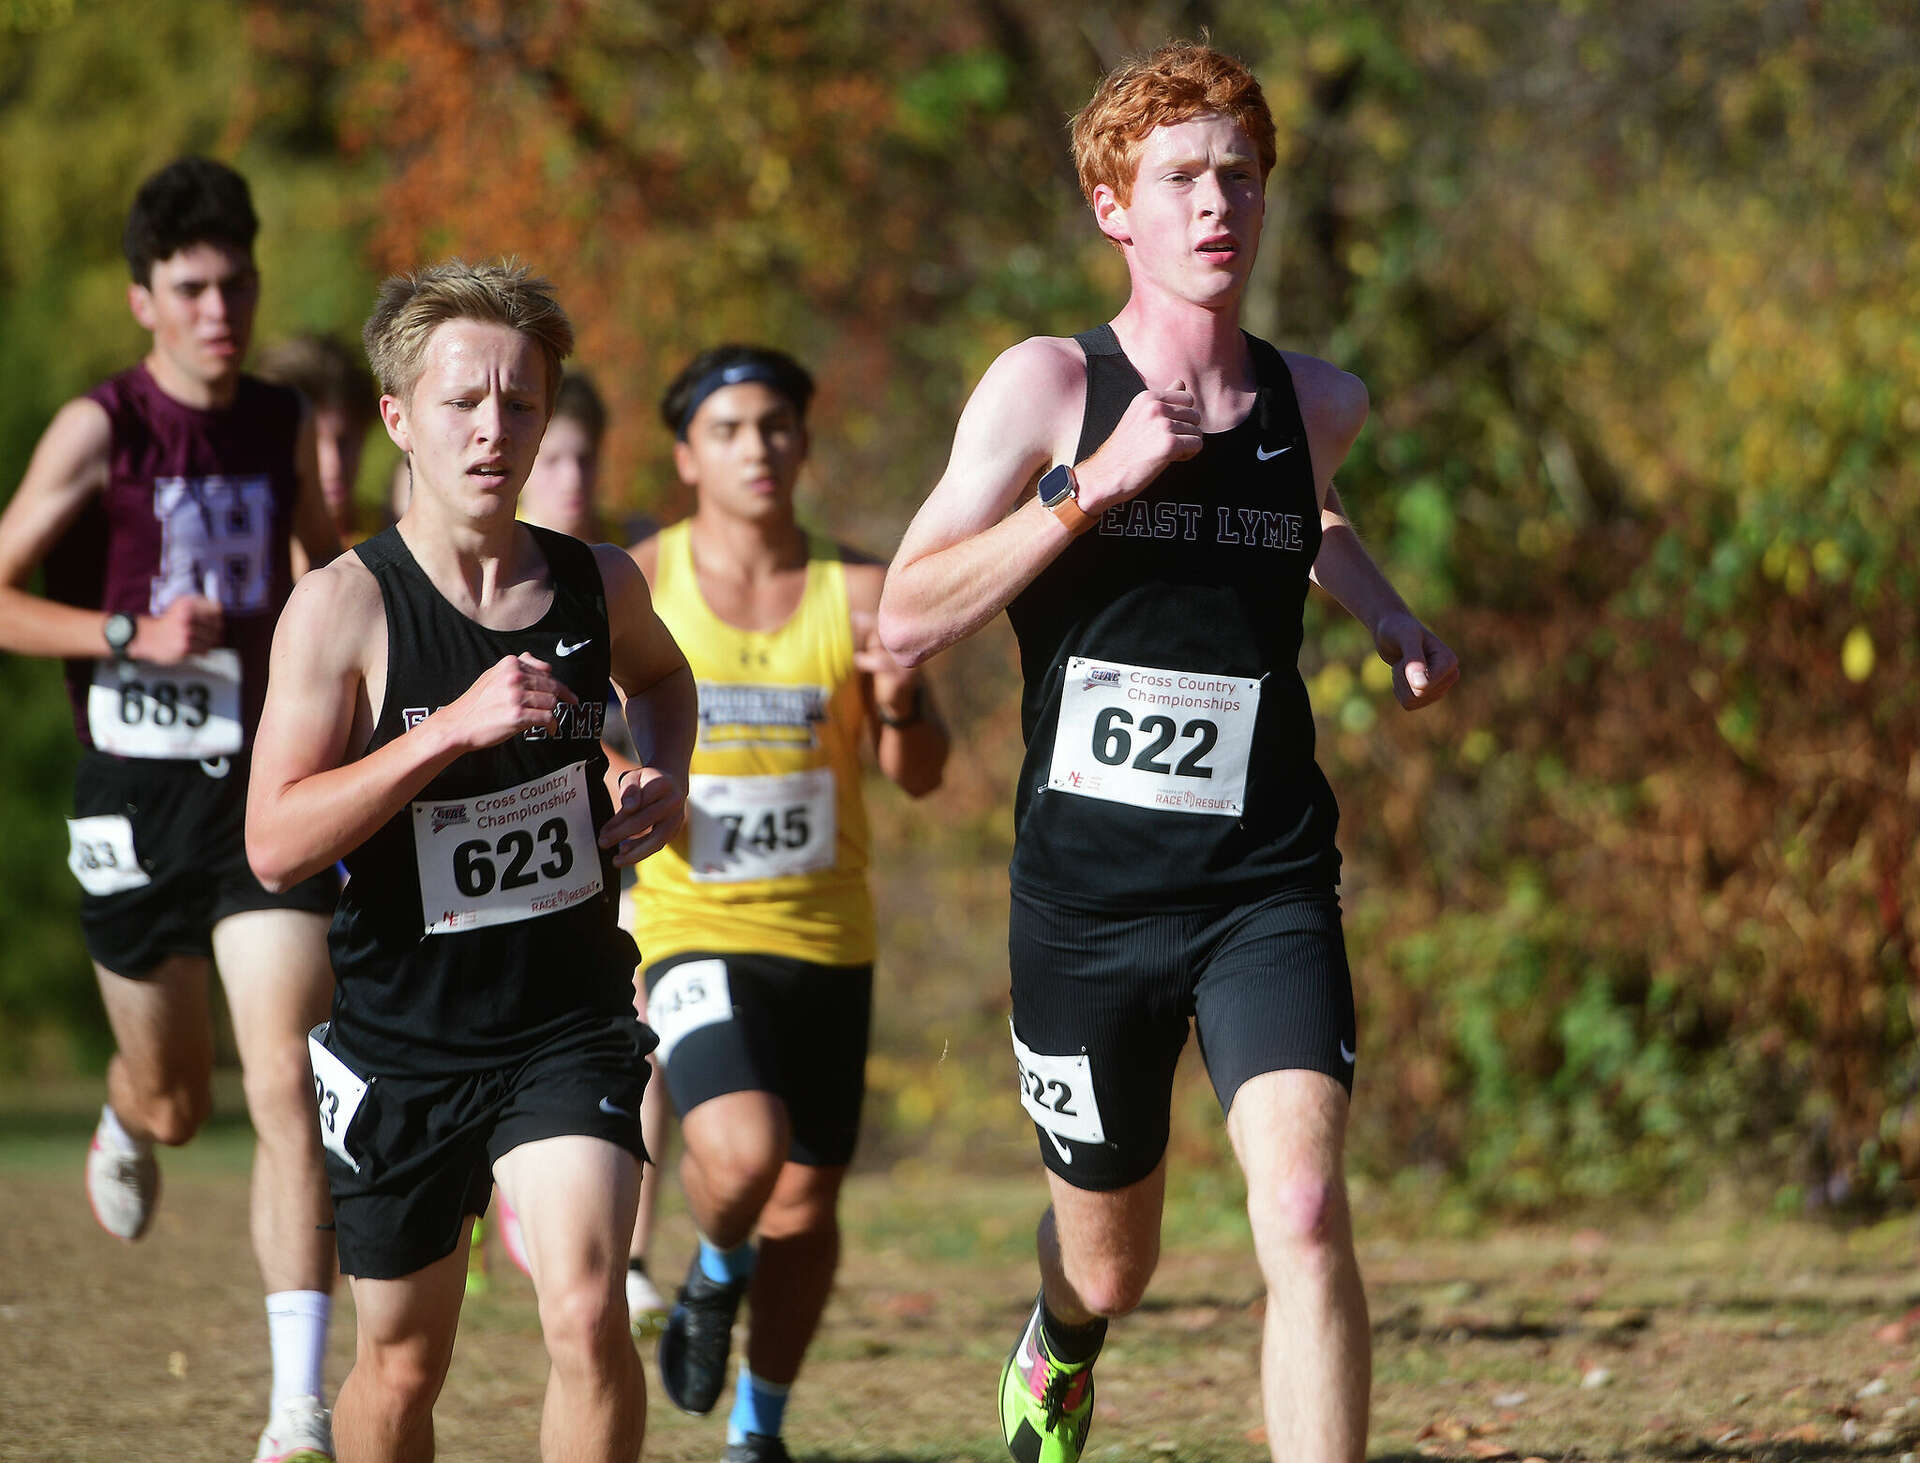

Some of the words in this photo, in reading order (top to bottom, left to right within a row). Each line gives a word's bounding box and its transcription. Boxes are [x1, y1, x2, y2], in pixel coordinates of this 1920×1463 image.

[1100, 500, 1202, 540] EAST
[1216, 507, 1303, 551] LYME
[120, 681, 210, 727] 683
[1127, 688, 1241, 713] Championships
[1130, 671, 1172, 688] Cross
[1178, 676, 1237, 695] Country
[1092, 706, 1219, 779] 622
[475, 793, 517, 813] Cross
[519, 774, 569, 800] Country
[477, 787, 578, 829] Championships
[1155, 793, 1183, 806] RACE
[1195, 798, 1232, 809] RESULT
[719, 806, 811, 855] 745
[453, 816, 574, 898] 623
